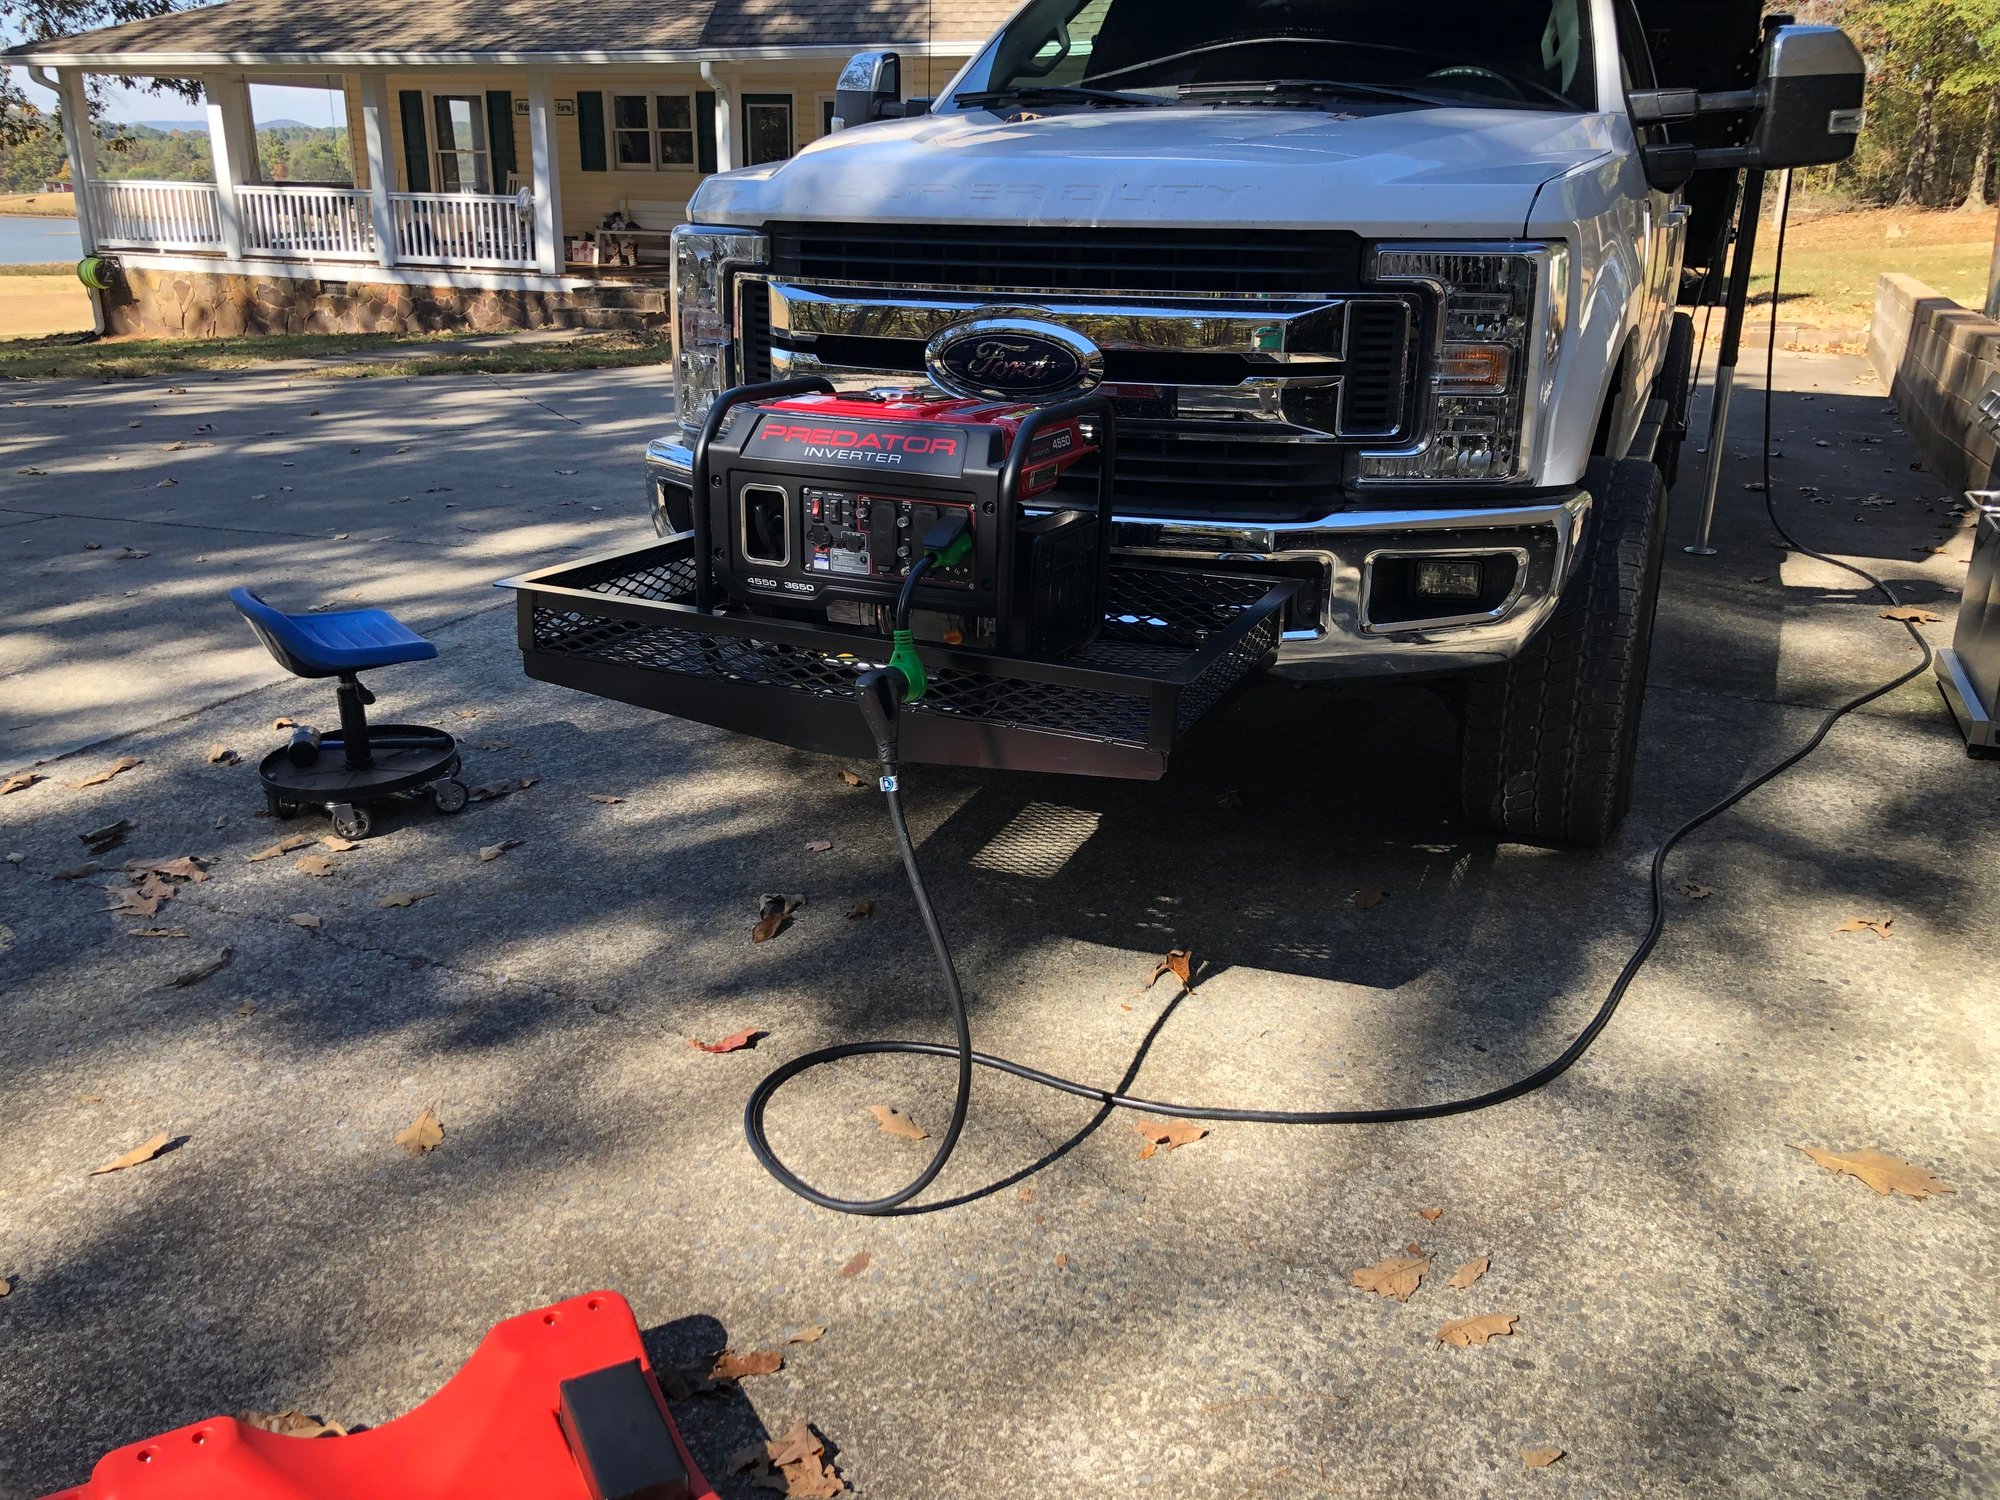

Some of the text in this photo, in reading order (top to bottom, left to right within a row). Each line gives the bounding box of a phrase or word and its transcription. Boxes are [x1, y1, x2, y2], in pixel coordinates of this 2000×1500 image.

[557, 103, 571, 112] Farm
[835, 183, 1252, 201] SUPER DUTY
[967, 341, 1051, 380] Ford
[760, 424, 957, 456] PREDATOR
[1052, 434, 1071, 449] 4550
[803, 446, 902, 464] INVERTER
[747, 577, 777, 587] 4550
[784, 581, 815, 592] 3650
